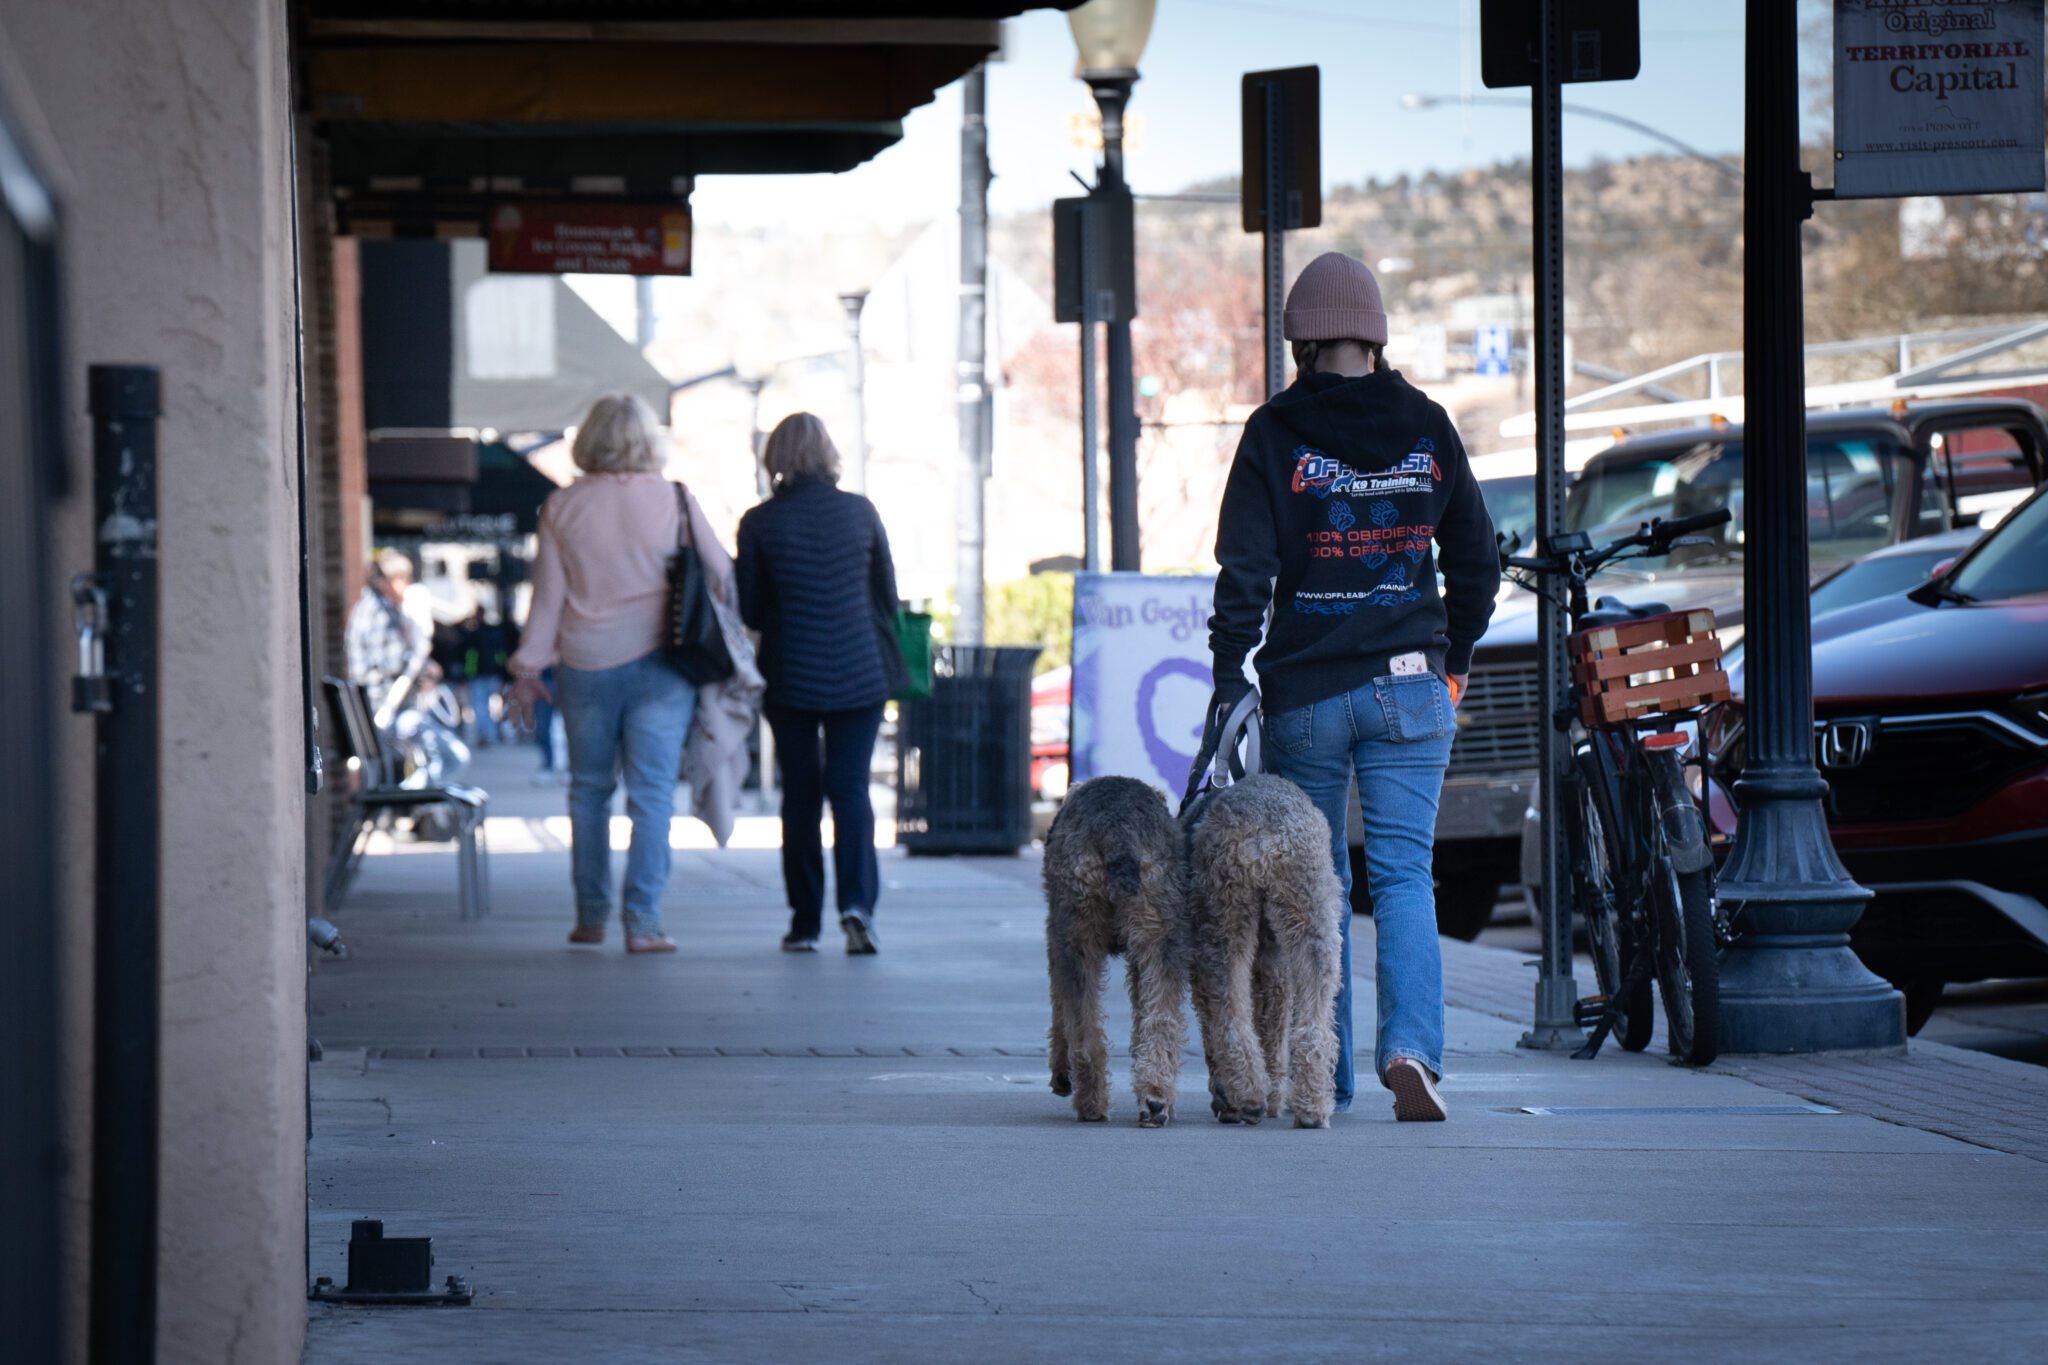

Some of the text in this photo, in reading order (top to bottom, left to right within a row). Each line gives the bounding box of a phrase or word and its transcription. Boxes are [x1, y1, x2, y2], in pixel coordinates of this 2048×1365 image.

[1885, 8, 1996, 36] Original
[1846, 41, 2030, 62] TERRITORIAL
[1889, 62, 2019, 100] Capital
[1352, 480, 1368, 490] K9
[1347, 524, 1434, 542] OBEDIENCE
